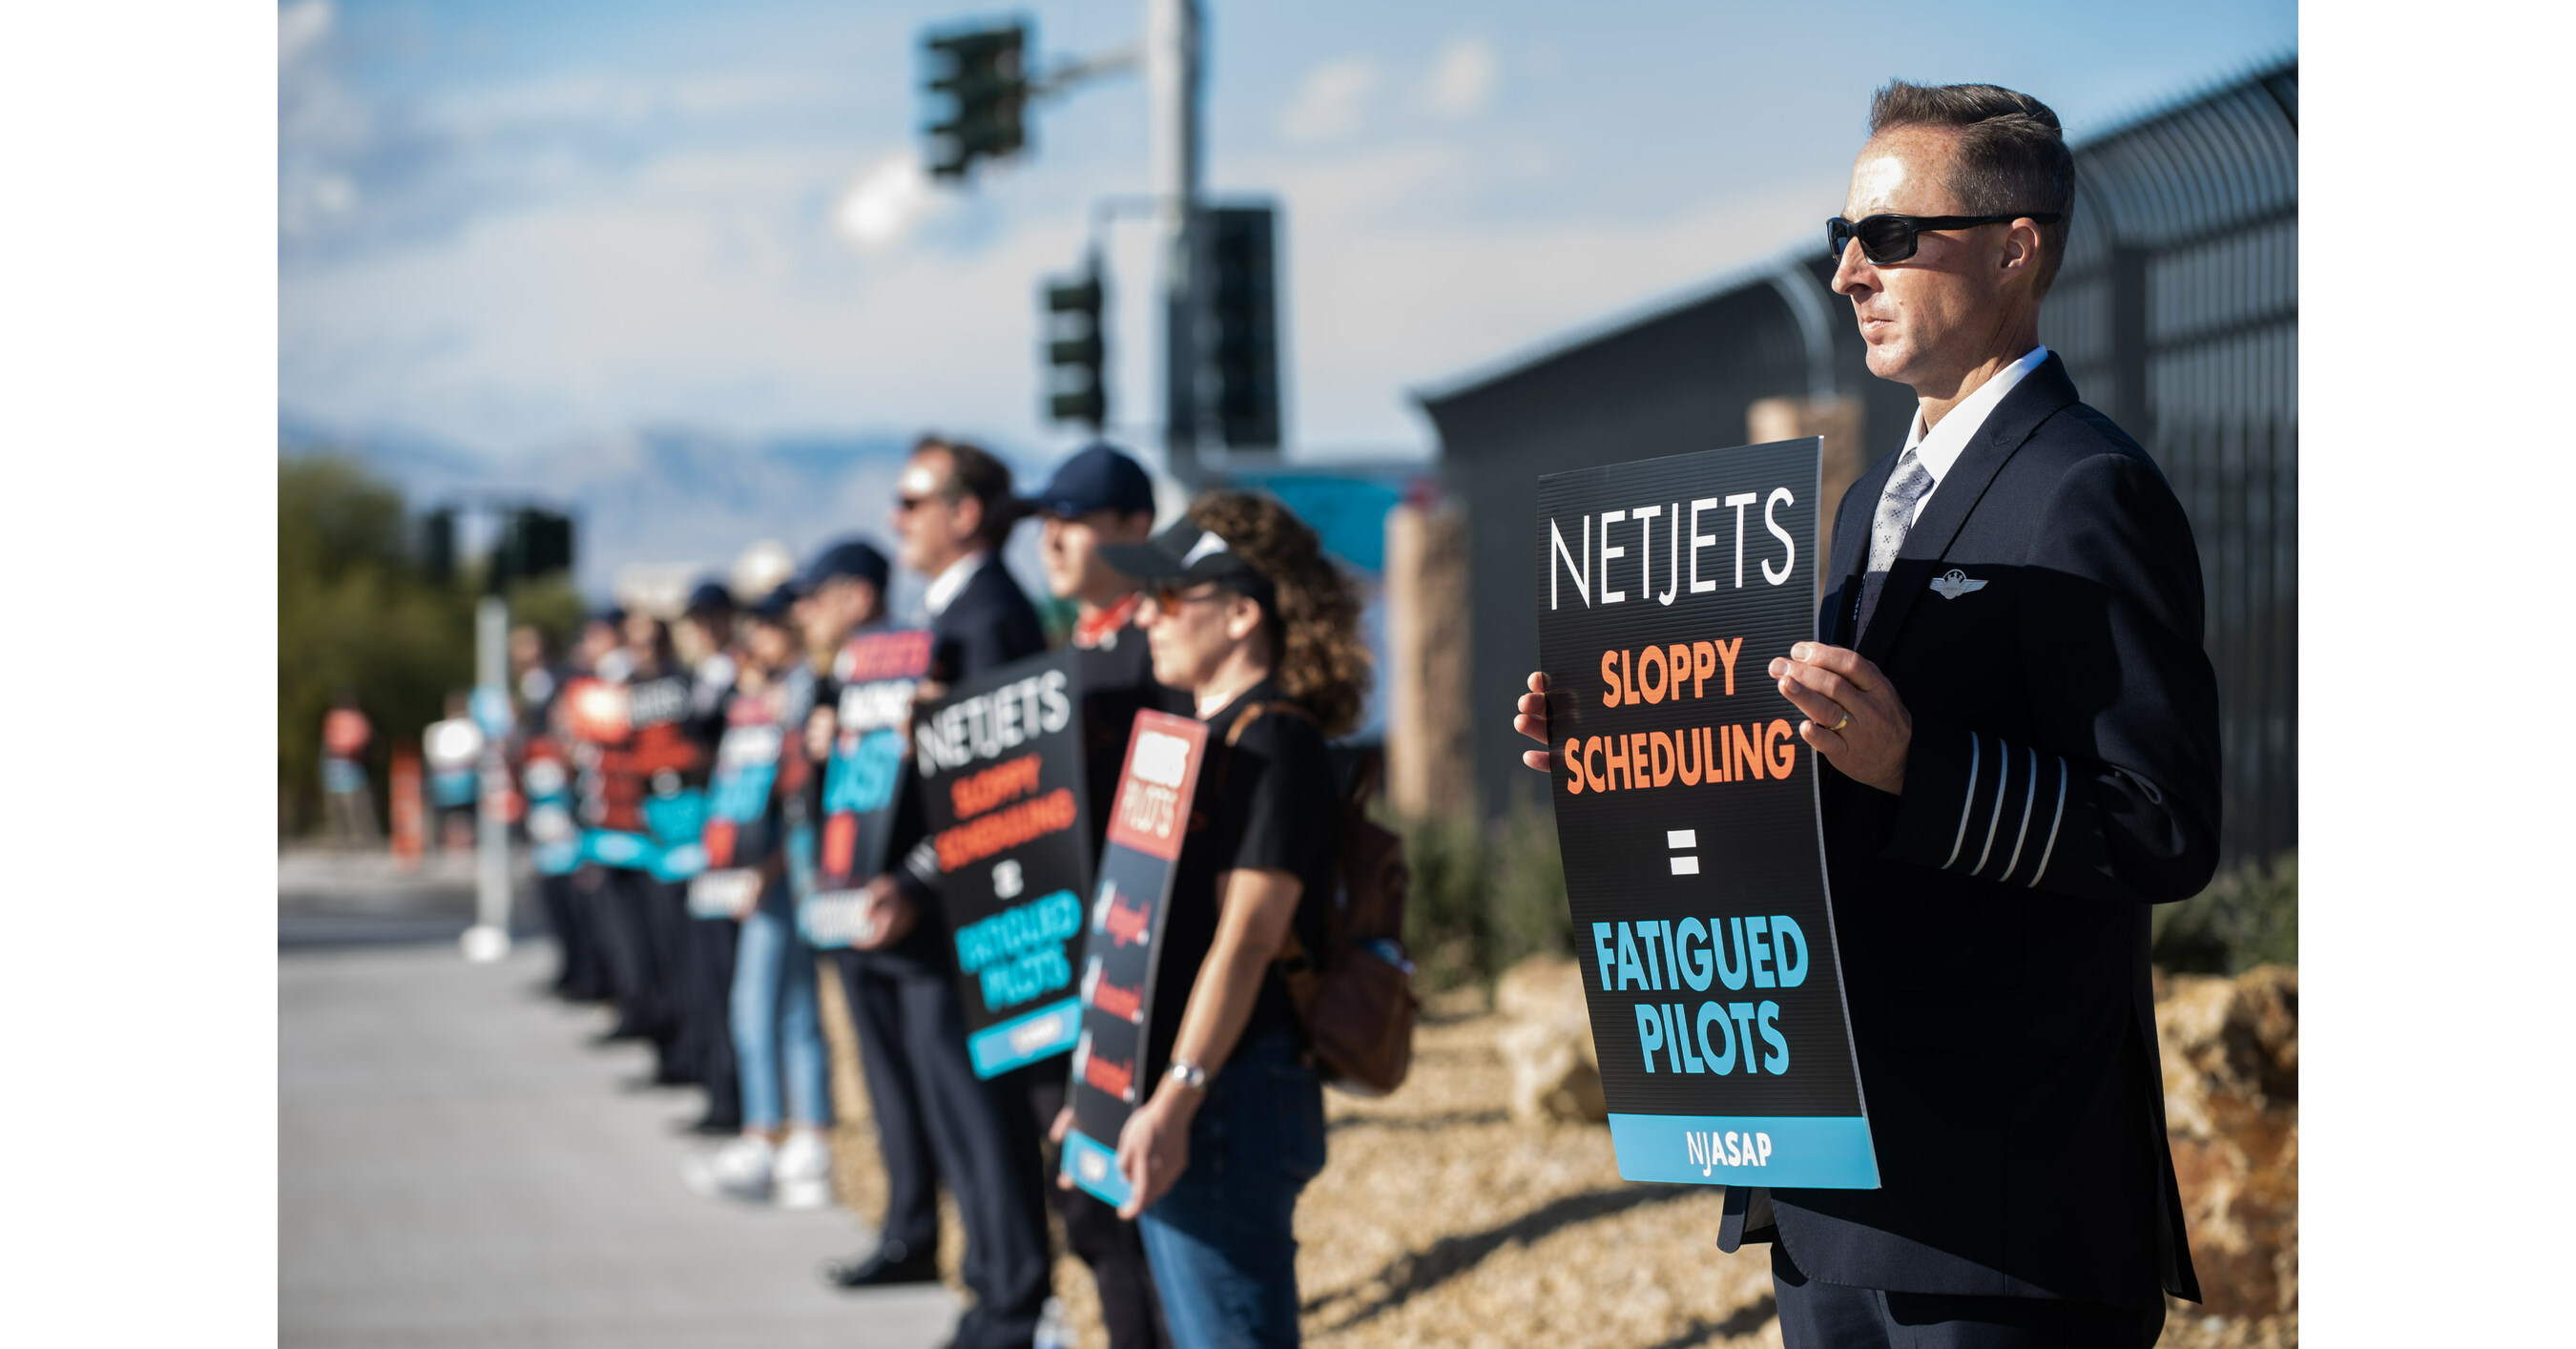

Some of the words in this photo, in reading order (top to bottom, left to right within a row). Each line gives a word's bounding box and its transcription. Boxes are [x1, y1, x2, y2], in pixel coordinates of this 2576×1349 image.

[1550, 487, 1796, 611] NETJETS
[1601, 636, 1744, 709] SLOPPY
[915, 670, 1070, 778] NETJETS
[1564, 718, 1796, 795] SCHEDULING
[1591, 915, 1809, 992] FATIGUED
[1634, 1000, 1790, 1076] PILOTS
[1686, 1131, 1773, 1177] NJASAP
